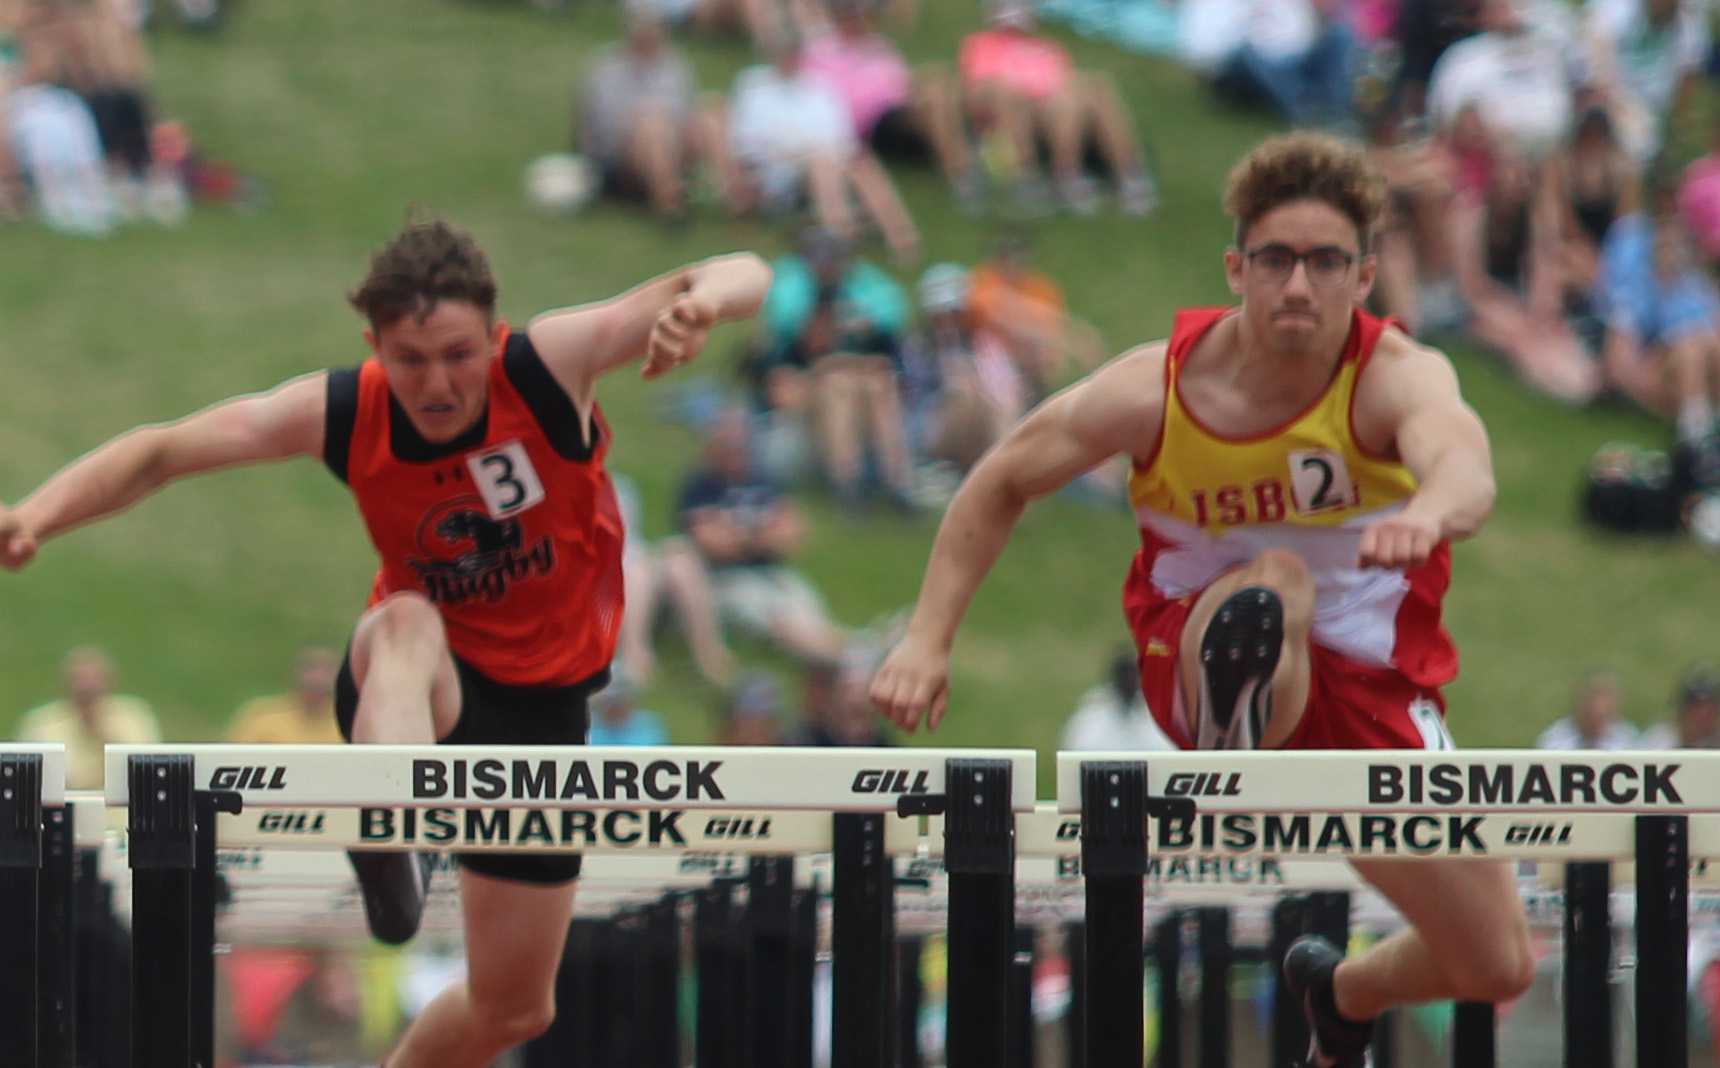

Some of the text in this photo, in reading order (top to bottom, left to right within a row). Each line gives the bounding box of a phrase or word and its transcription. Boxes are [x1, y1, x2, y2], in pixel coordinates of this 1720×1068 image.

[480, 454, 526, 510] 3
[1301, 457, 1342, 508] 2
[418, 538, 554, 602] Rugby
[208, 758, 930, 802] GILL BISMARCK GILL
[1163, 763, 1685, 806] GILL BISMARCK
[257, 807, 773, 844] GILL BISMARCK GILL
[1158, 814, 1574, 852] BISMARCK GILL
